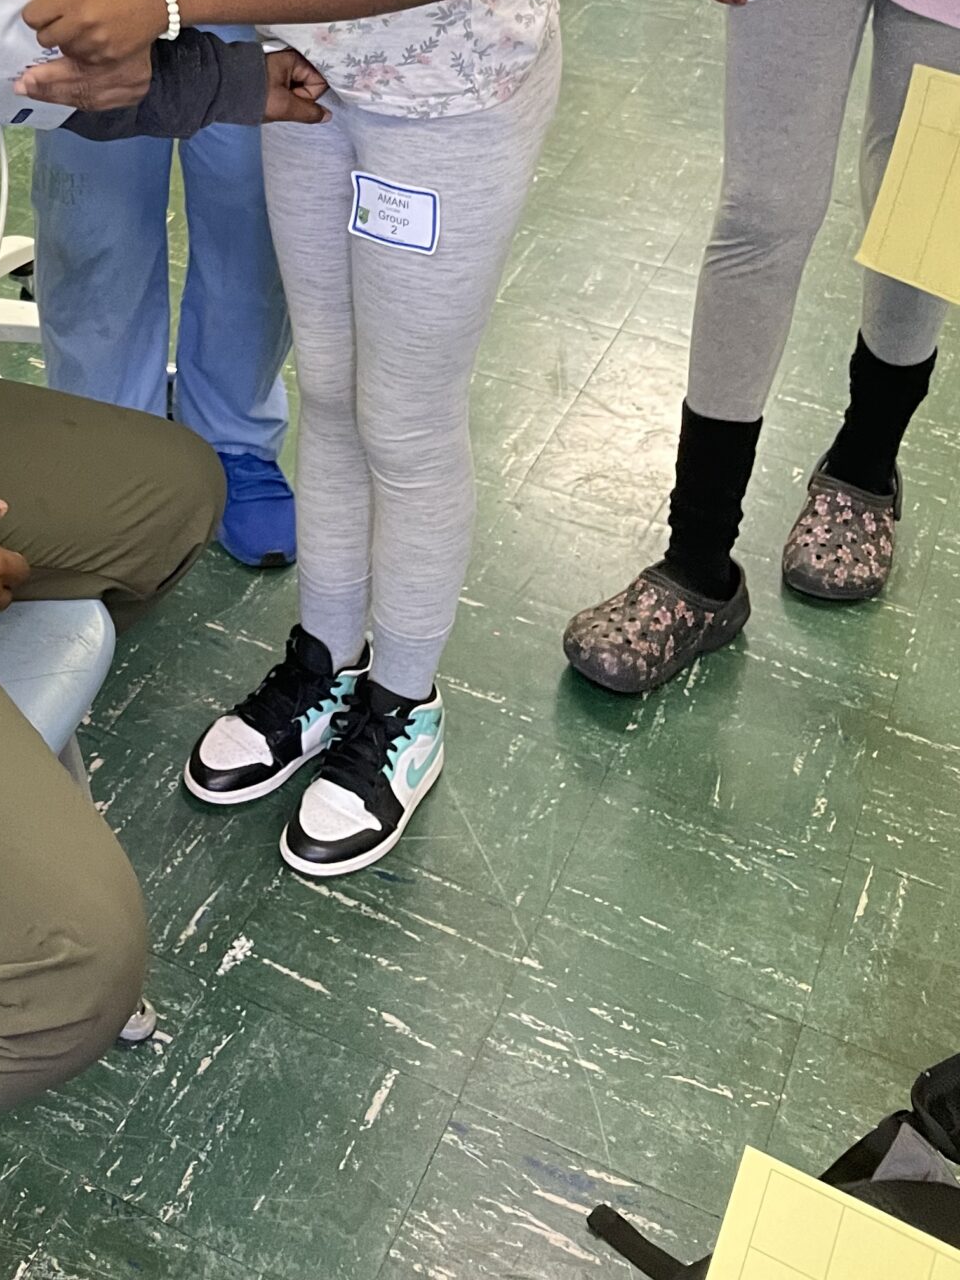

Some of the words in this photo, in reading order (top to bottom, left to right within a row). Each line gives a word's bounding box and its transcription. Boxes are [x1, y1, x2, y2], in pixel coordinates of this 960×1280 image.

[377, 193, 410, 210] AMANI
[378, 209, 410, 228] Group
[391, 224, 398, 235] 2
